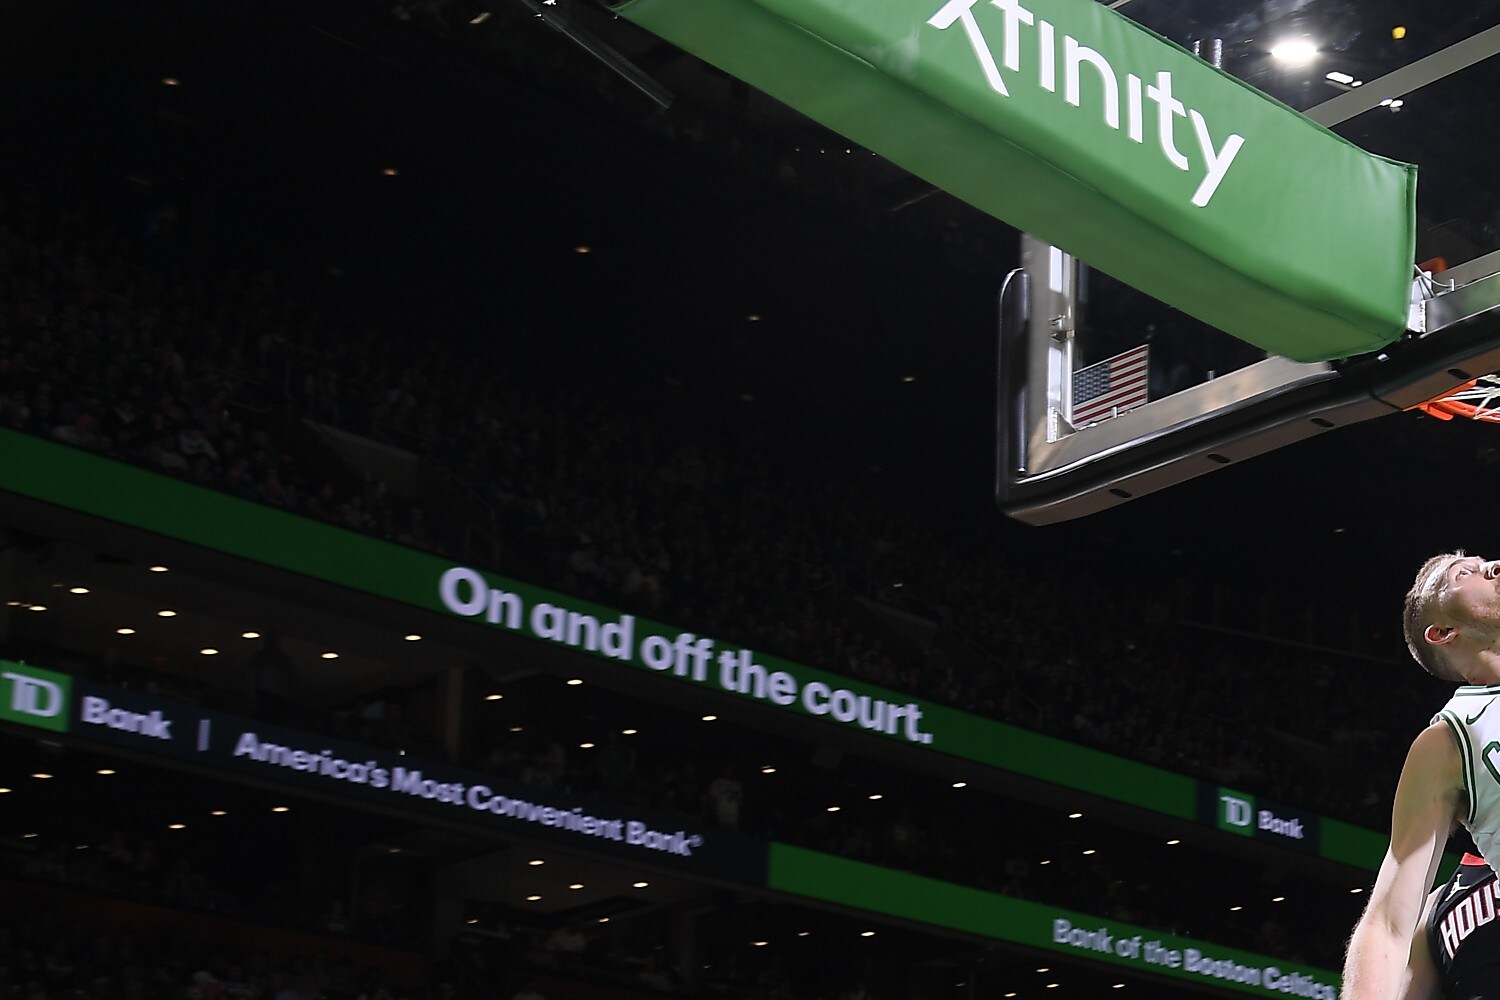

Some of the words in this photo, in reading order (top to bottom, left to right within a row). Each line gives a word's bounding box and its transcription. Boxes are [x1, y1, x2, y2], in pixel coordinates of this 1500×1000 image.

[439, 566, 523, 630] On
[530, 602, 635, 661] and
[640, 632, 715, 682] off
[717, 649, 798, 705] the
[802, 681, 934, 744] court.
[1, 671, 63, 718] TD
[81, 695, 172, 739] Bank
[234, 732, 389, 788] America's
[391, 766, 465, 805] Most
[467, 785, 624, 841] Convenient
[1221, 796, 1252, 827] TD
[1258, 810, 1304, 839] Bank
[1053, 918, 1114, 954] Bank
[1115, 935, 1143, 959] of
[1144, 940, 1182, 969] the
[1183, 948, 1262, 987] Boston
